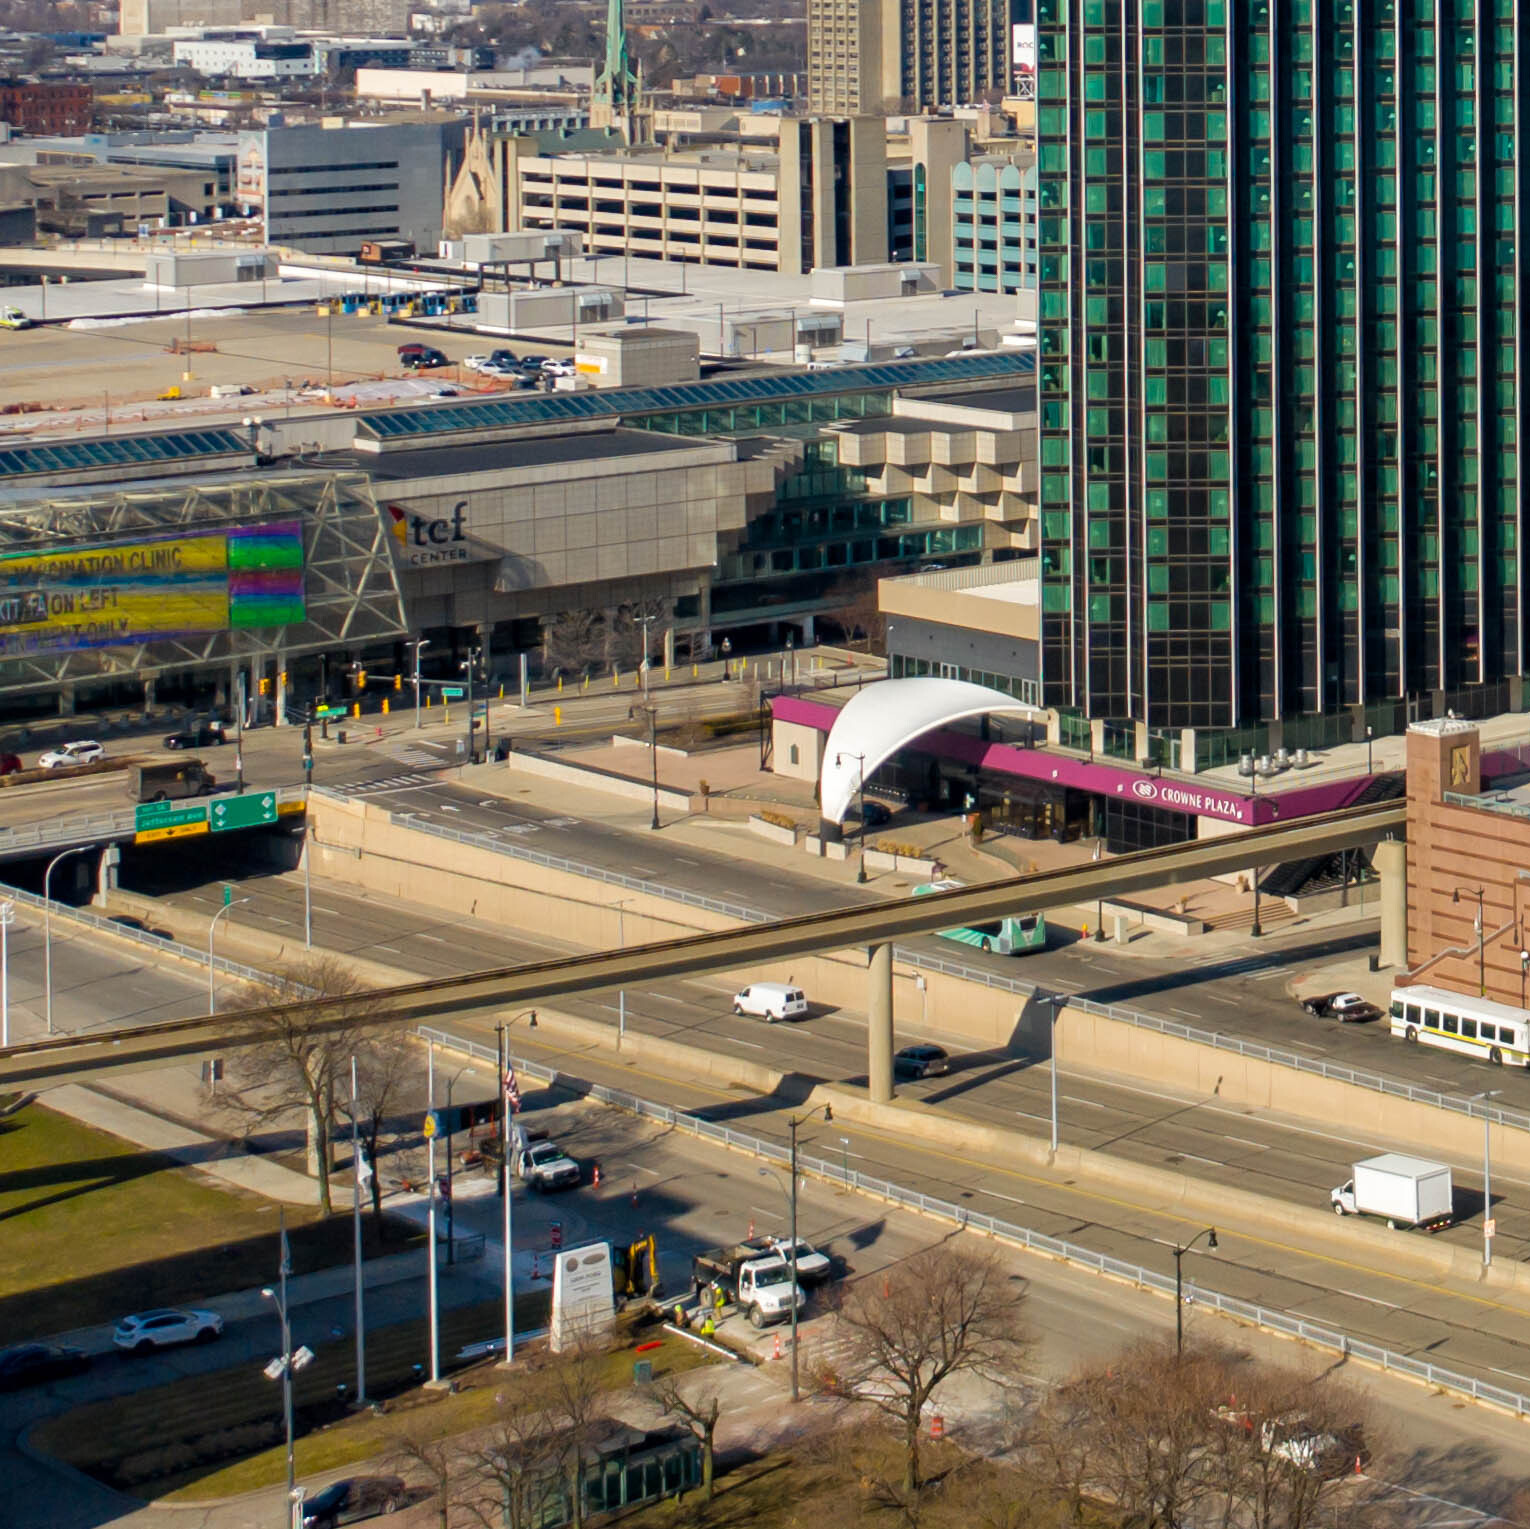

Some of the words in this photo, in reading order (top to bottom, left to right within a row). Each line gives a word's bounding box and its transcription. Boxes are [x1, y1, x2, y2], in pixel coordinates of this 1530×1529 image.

[411, 500, 468, 546] tcf
[129, 547, 183, 570] CLINIC
[410, 548, 467, 565] CENTER
[51, 593, 74, 615] ON
[1161, 787, 1202, 809] CROWNE
[1205, 797, 1236, 817] PLAZA
